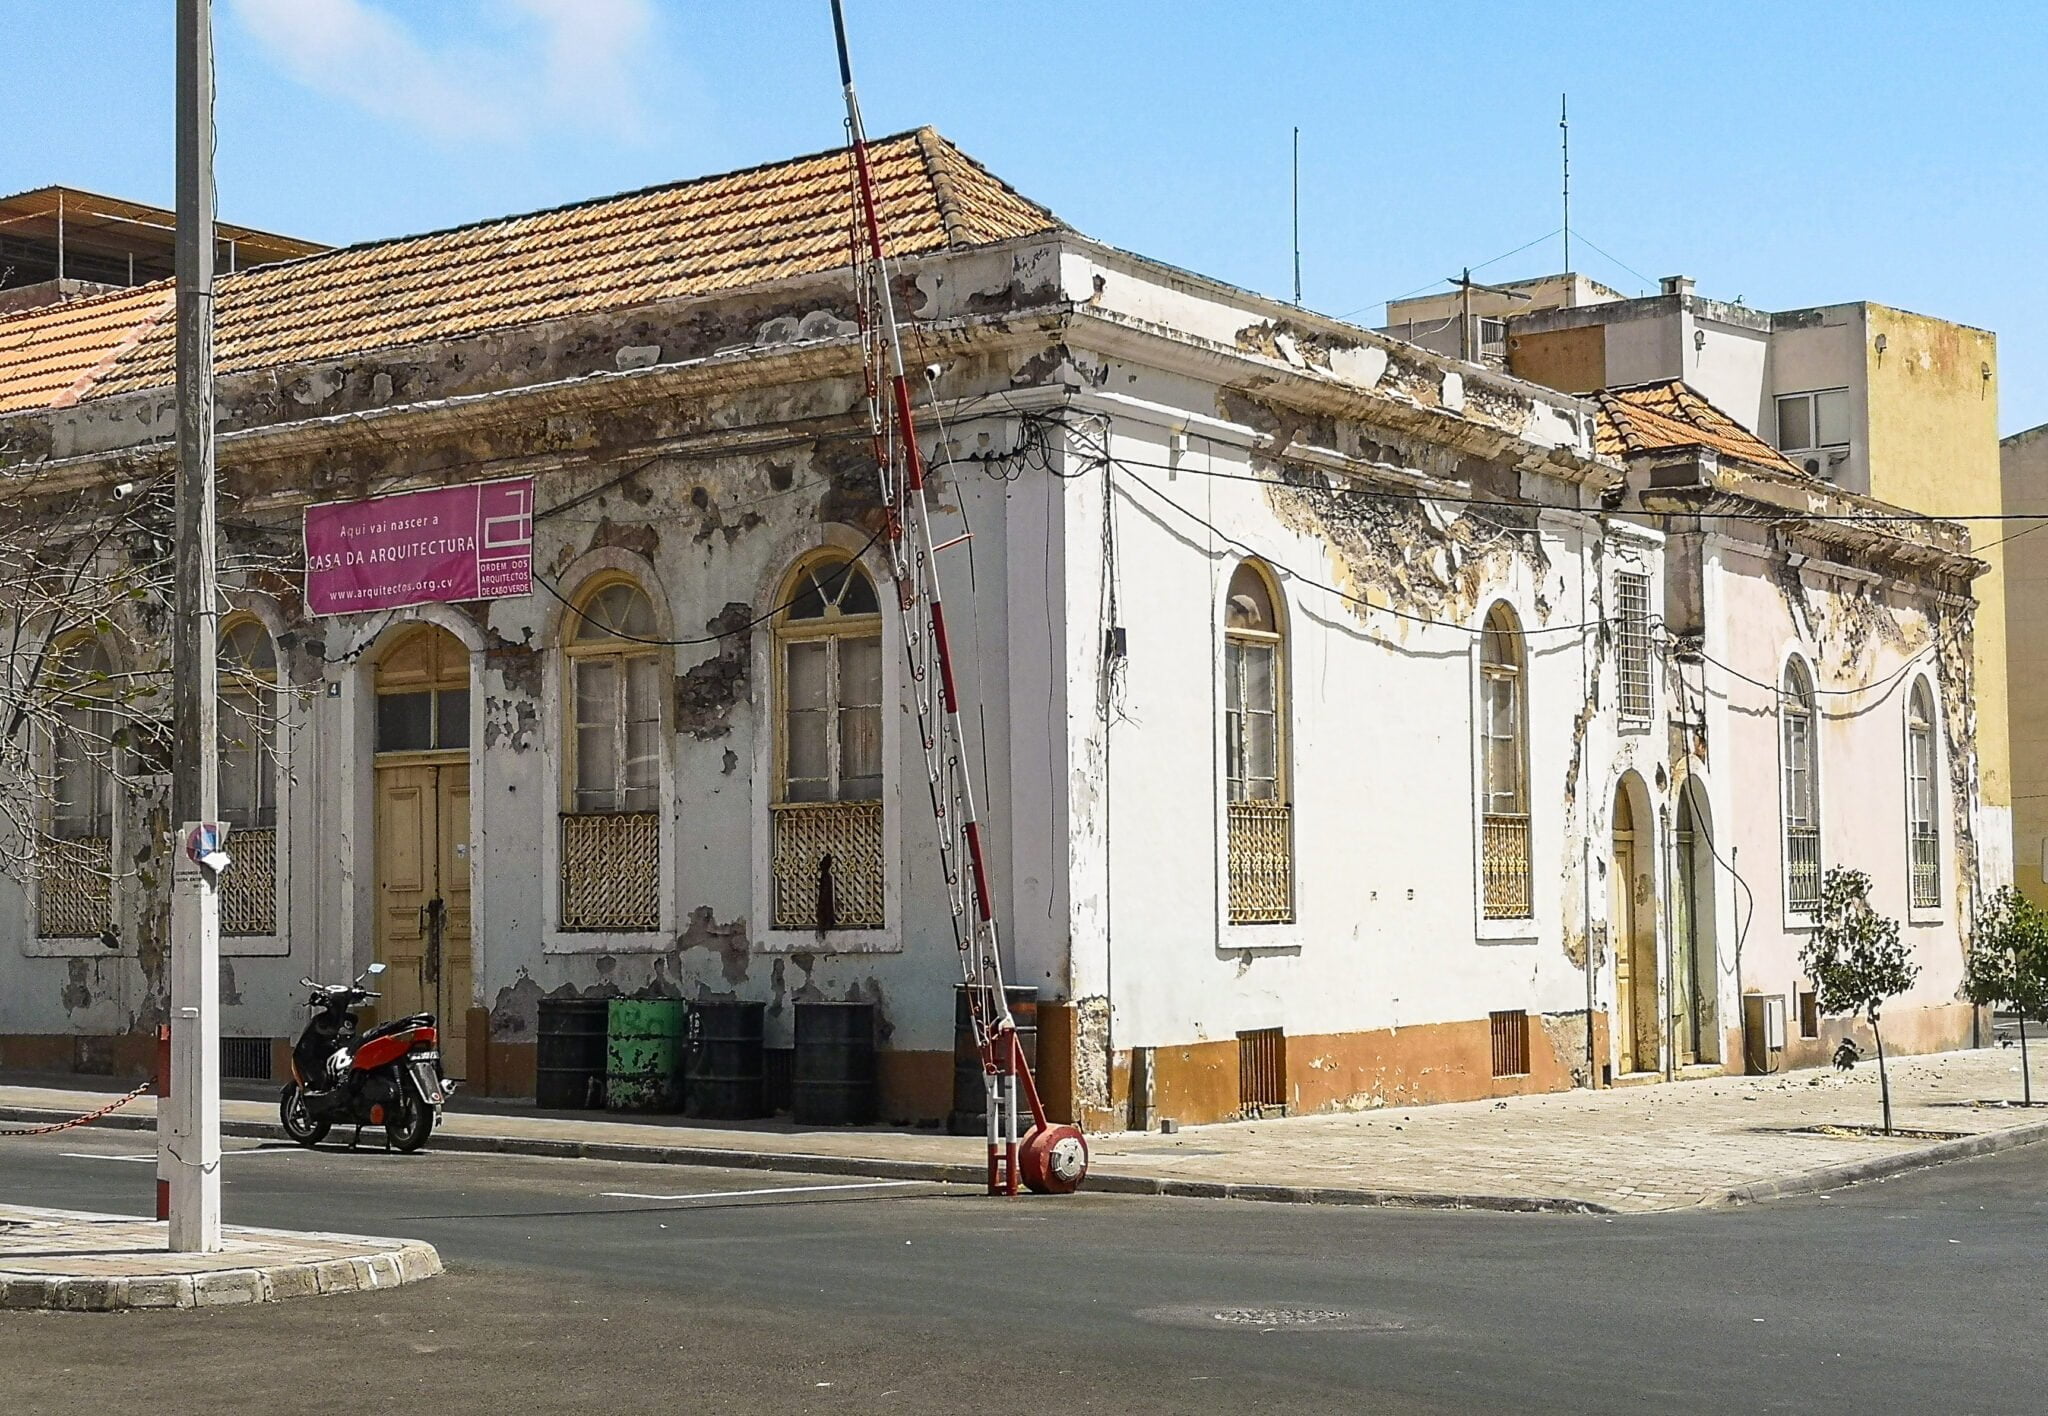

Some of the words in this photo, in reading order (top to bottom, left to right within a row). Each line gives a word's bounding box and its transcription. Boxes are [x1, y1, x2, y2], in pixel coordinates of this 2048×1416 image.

[340, 523, 366, 539] Aqui
[370, 520, 387, 534] vai
[391, 517, 428, 531] nascer
[432, 515, 439, 525] a
[309, 552, 341, 570] CASA
[346, 550, 364, 566] DA
[369, 536, 476, 563] ARQUITECTURA
[480, 562, 507, 572] ORDEM
[511, 560, 528, 569] DOS
[481, 571, 529, 584] ARQUITECTOS
[329, 579, 453, 601] www.arquitectos.org.cv
[481, 587, 490, 596] DE
[490, 585, 508, 595] CABO
[508, 583, 529, 593] VERDE
[330, 683, 337, 695] 4
